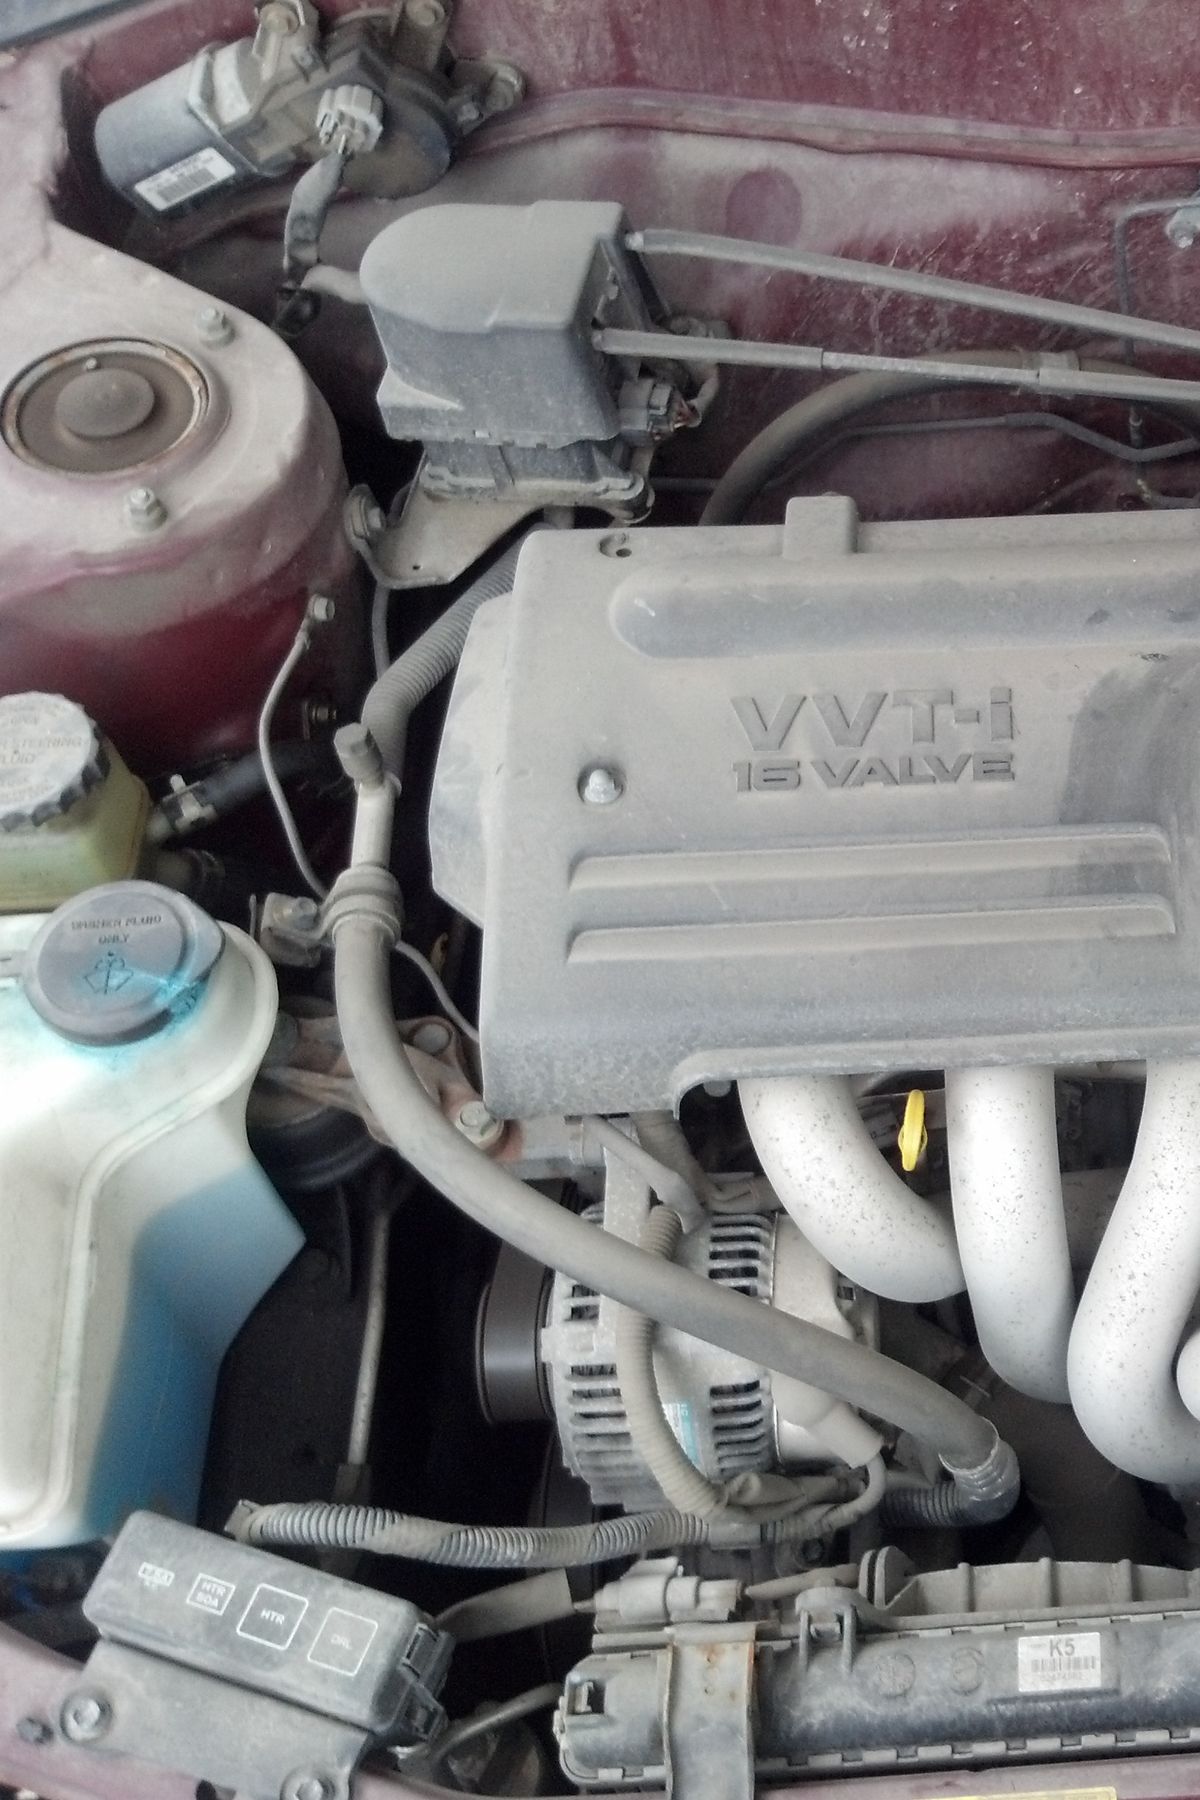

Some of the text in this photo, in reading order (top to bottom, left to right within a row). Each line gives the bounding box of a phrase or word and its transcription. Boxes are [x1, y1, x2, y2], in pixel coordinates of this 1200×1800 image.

[730, 686, 1013, 751] VVT-i
[732, 752, 1015, 792] 16 VALVE
[98, 932, 131, 944] ONLY
[201, 1581, 226, 1596] HTR
[260, 1608, 286, 1626] HTR
[1049, 1638, 1076, 1657] K5
